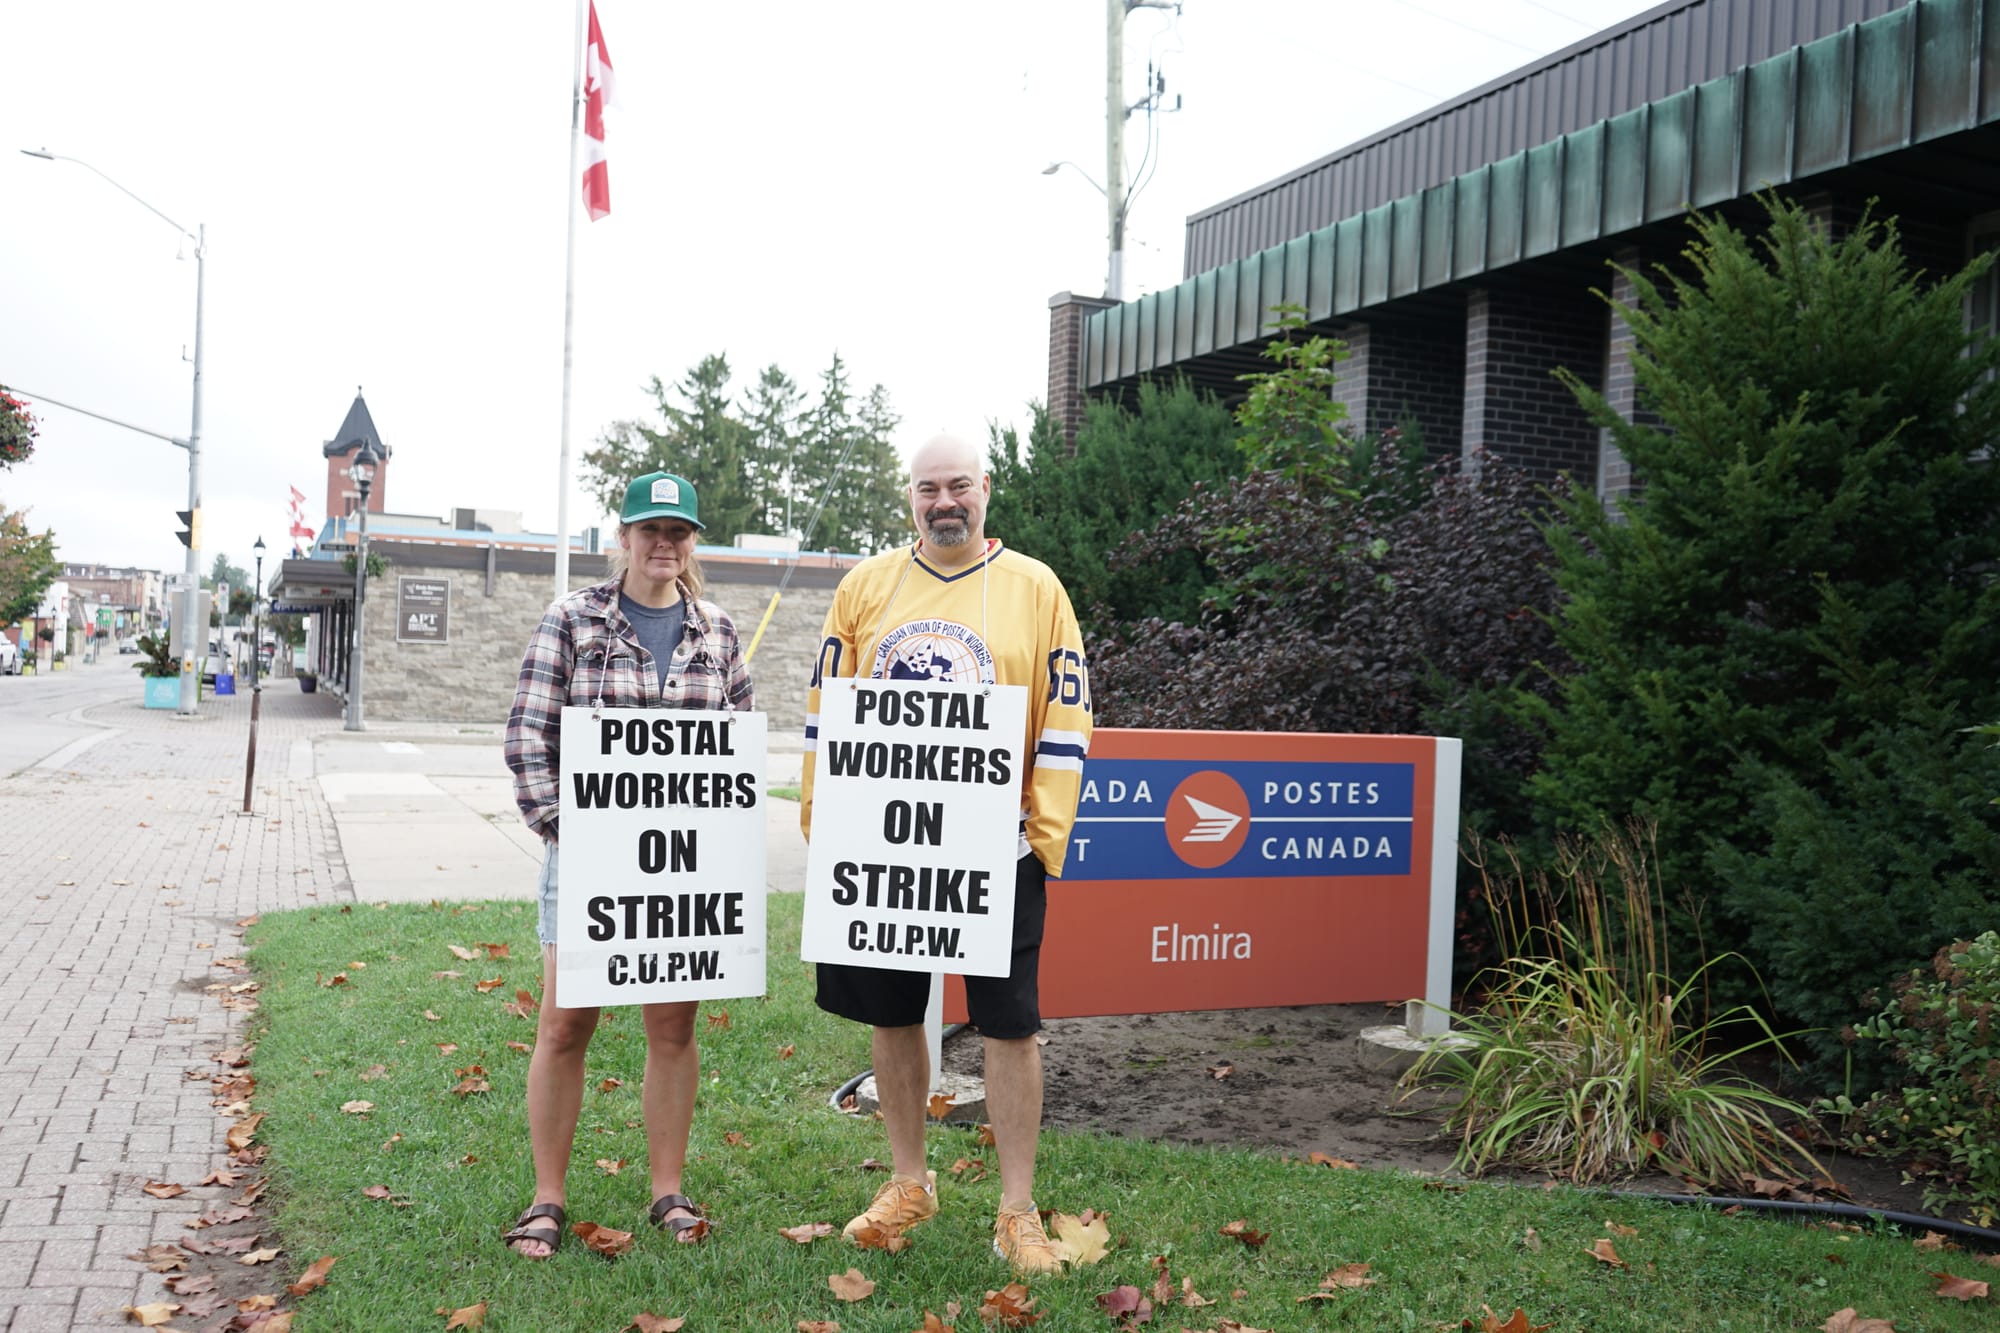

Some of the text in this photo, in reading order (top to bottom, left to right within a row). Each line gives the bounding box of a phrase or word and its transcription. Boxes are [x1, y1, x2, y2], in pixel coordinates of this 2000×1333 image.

[877, 621, 992, 667] CANADIAN UNION OF POSTAL WORKERS
[855, 689, 990, 731] POSTAL
[600, 718, 735, 756] POSTAL
[828, 740, 1012, 786] WORKERS
[572, 772, 757, 809] WORKERS
[1080, 780, 1153, 803] ADA
[1263, 781, 1380, 804] POSTES
[883, 799, 944, 847] ON
[638, 828, 697, 875] ON
[1261, 836, 1393, 860] CANADA
[831, 860, 990, 916] STRIKE
[587, 891, 744, 942] STRIKE
[847, 919, 965, 959] C.U.P.W.
[1151, 923, 1252, 963] Elmira
[607, 949, 725, 986] C.U.P.W.
